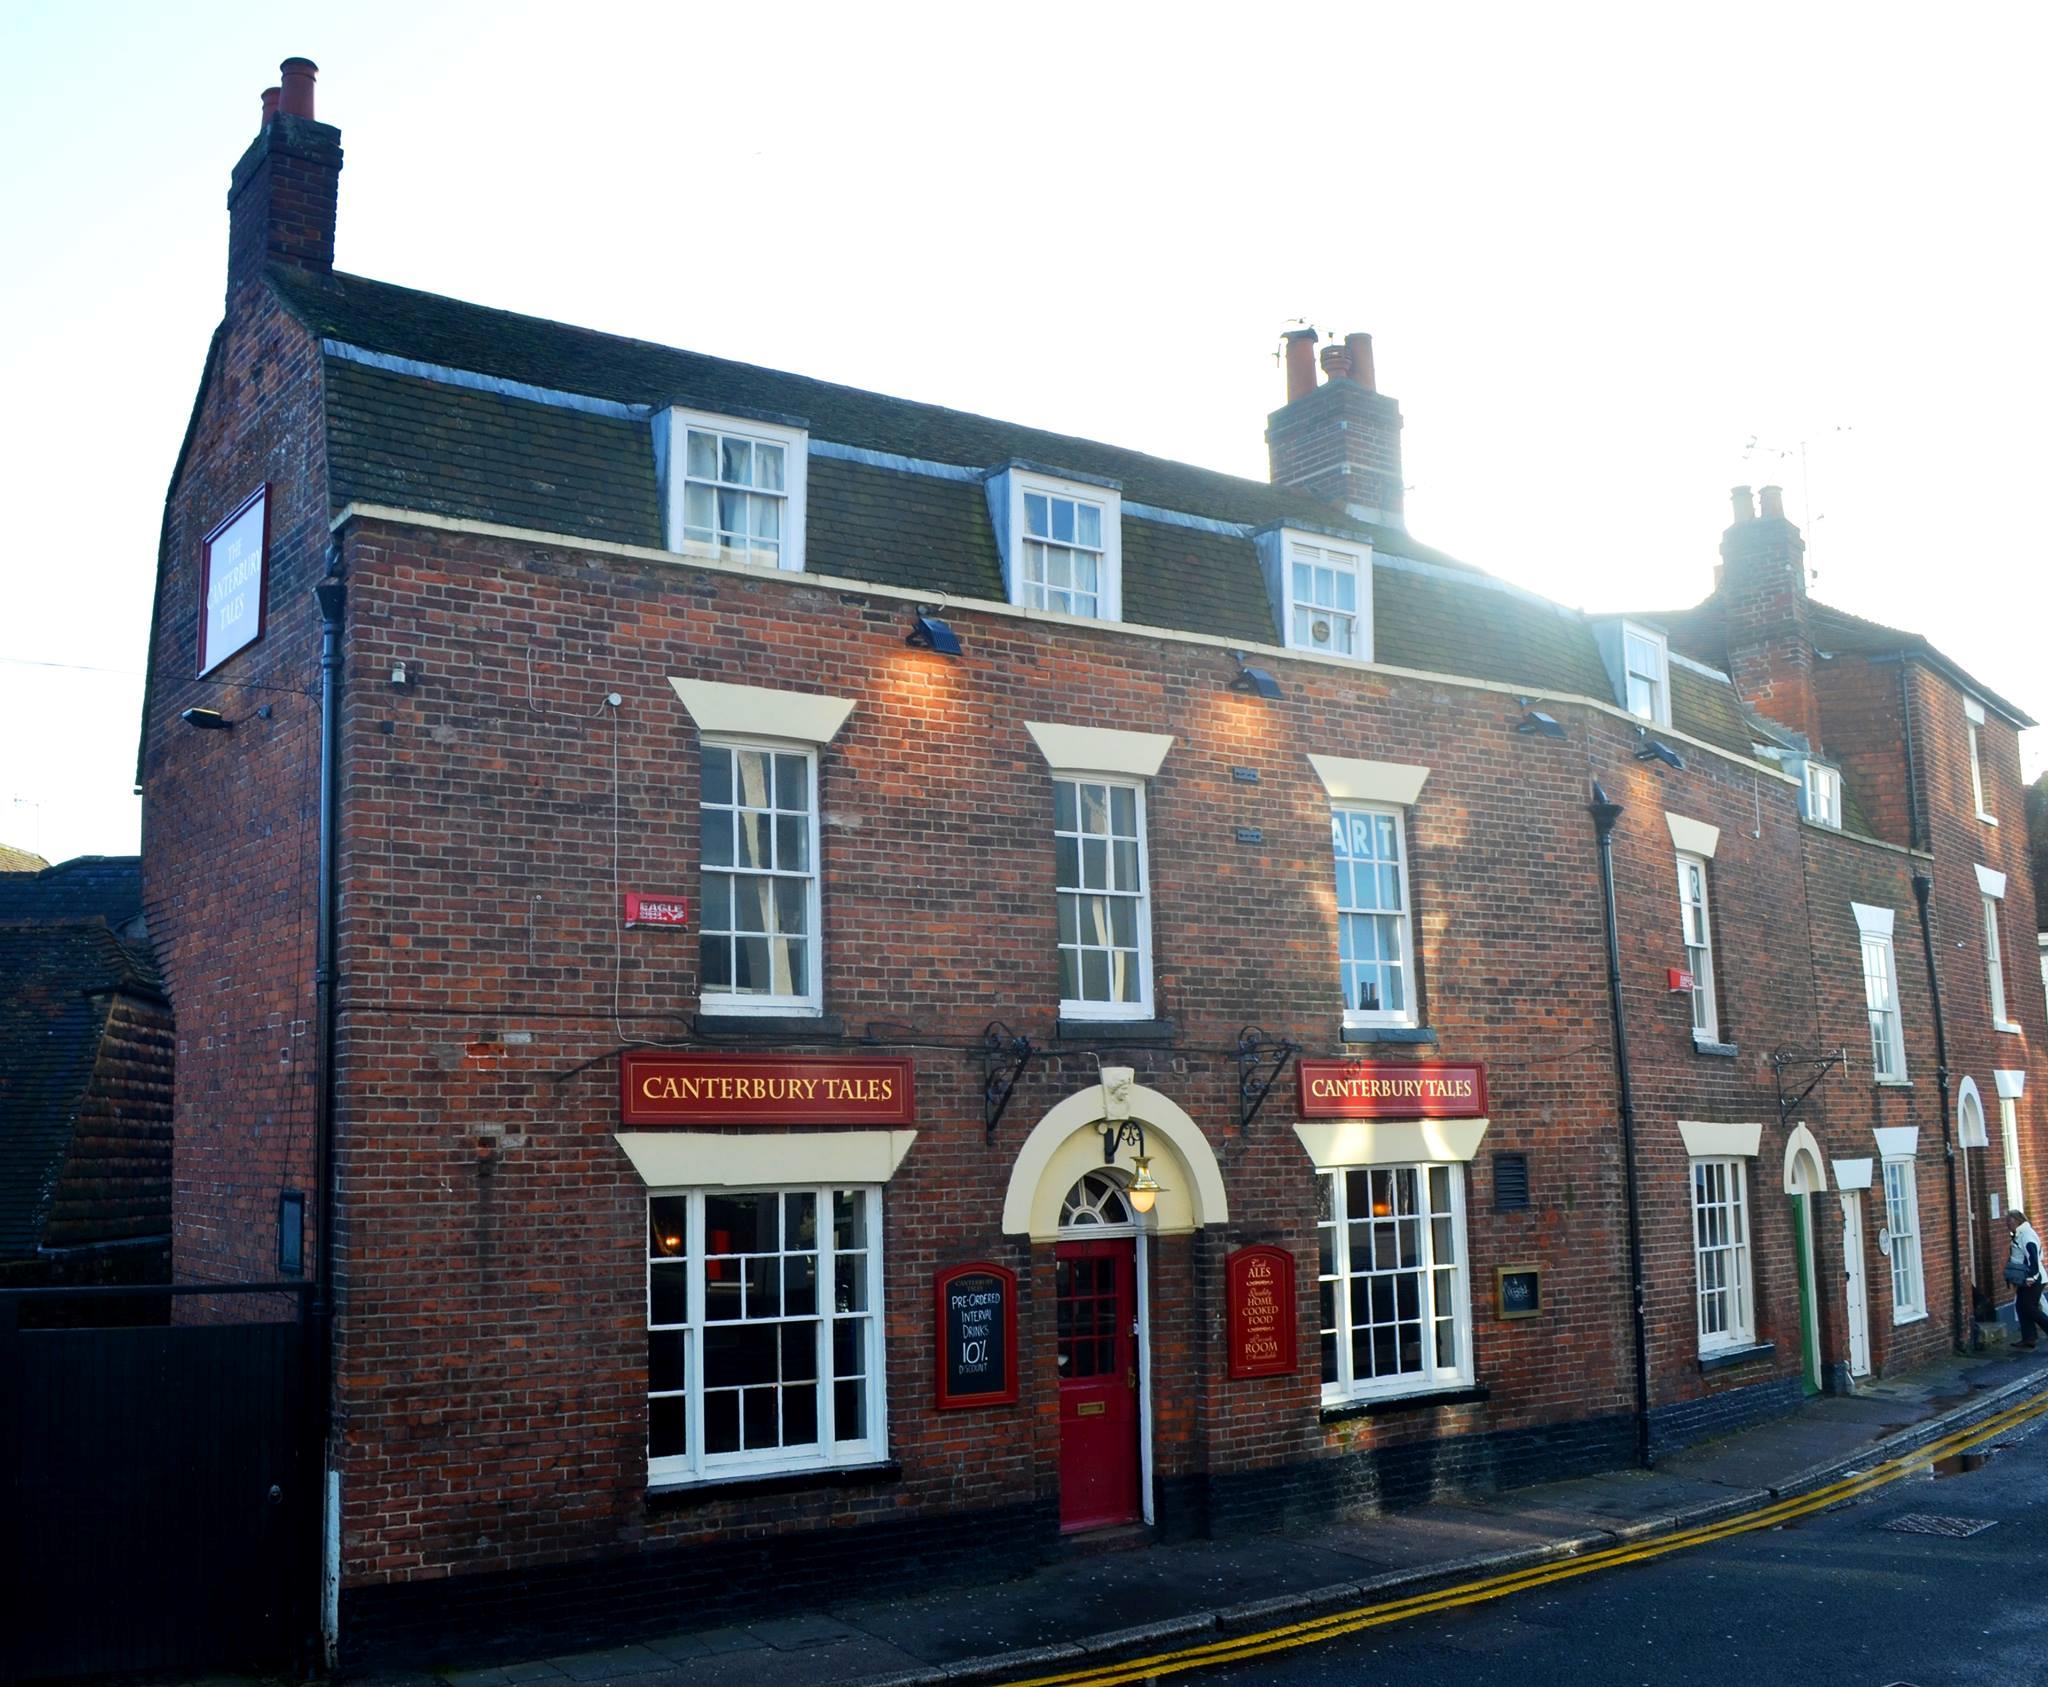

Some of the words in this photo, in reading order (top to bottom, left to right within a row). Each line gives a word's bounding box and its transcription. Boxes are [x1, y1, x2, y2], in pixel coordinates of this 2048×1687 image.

[228, 537, 242, 564] THE
[1331, 817, 1392, 856] ART
[640, 901, 683, 913] EAGLE
[642, 1075, 820, 1100] CANTERBURY
[822, 1077, 893, 1102] TALES
[1311, 1078, 1424, 1098] CANTERBURY
[1425, 1079, 1472, 1099] TALES
[1248, 1267, 1271, 1278] ALES
[952, 1293, 1000, 1310] PRE-ORDERED
[1247, 1297, 1273, 1307] HOME
[1242, 1306, 1279, 1317] COOKED
[1249, 1316, 1273, 1325] FOOD
[963, 1324, 989, 1339] DRINKS
[963, 1340, 988, 1364] 10%
[1245, 1342, 1278, 1354] ROOM
